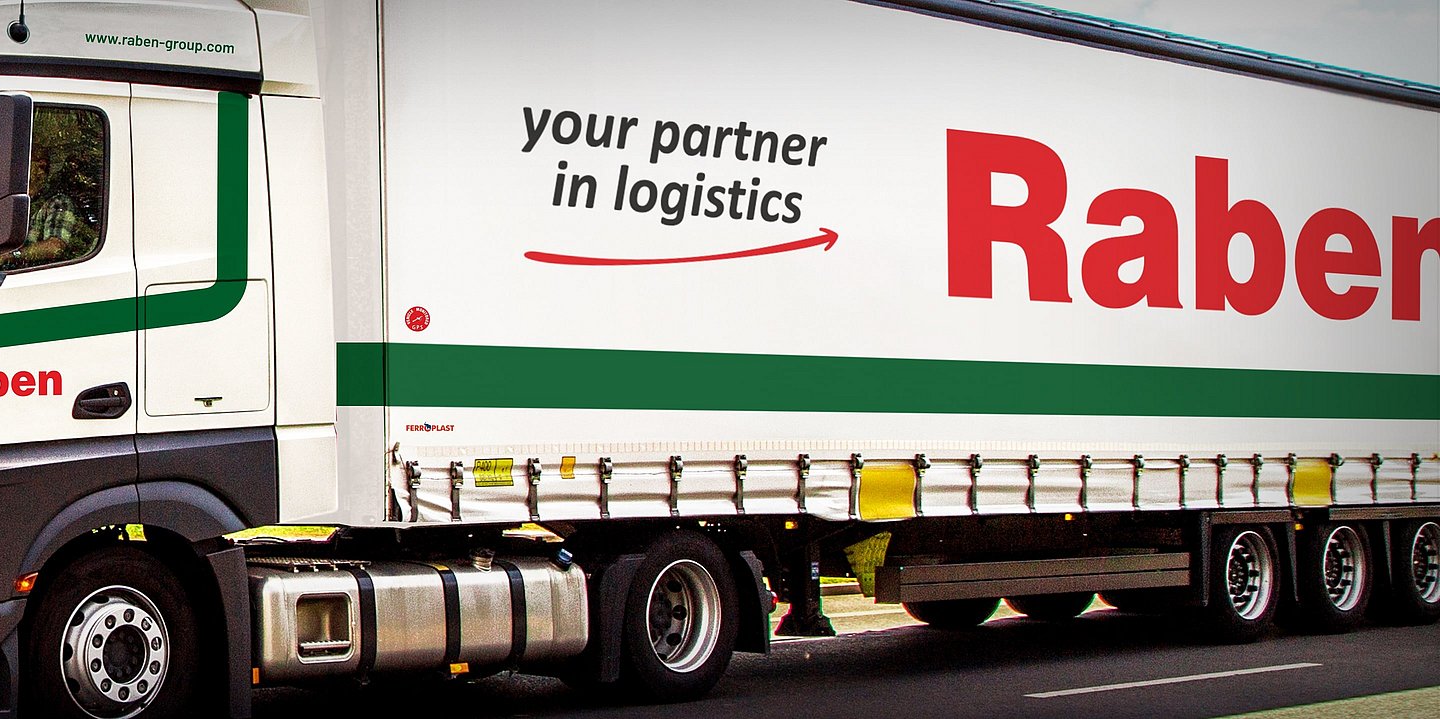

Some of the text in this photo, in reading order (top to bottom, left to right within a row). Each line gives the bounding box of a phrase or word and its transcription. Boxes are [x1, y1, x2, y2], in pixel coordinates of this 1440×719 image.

[85, 33, 235, 54] www.raben-group.com
[521, 106, 827, 166] your partner
[552, 160, 803, 226] in logistics
[946, 128, 1440, 322] Raben
[405, 423, 455, 432] FERROPLAST
